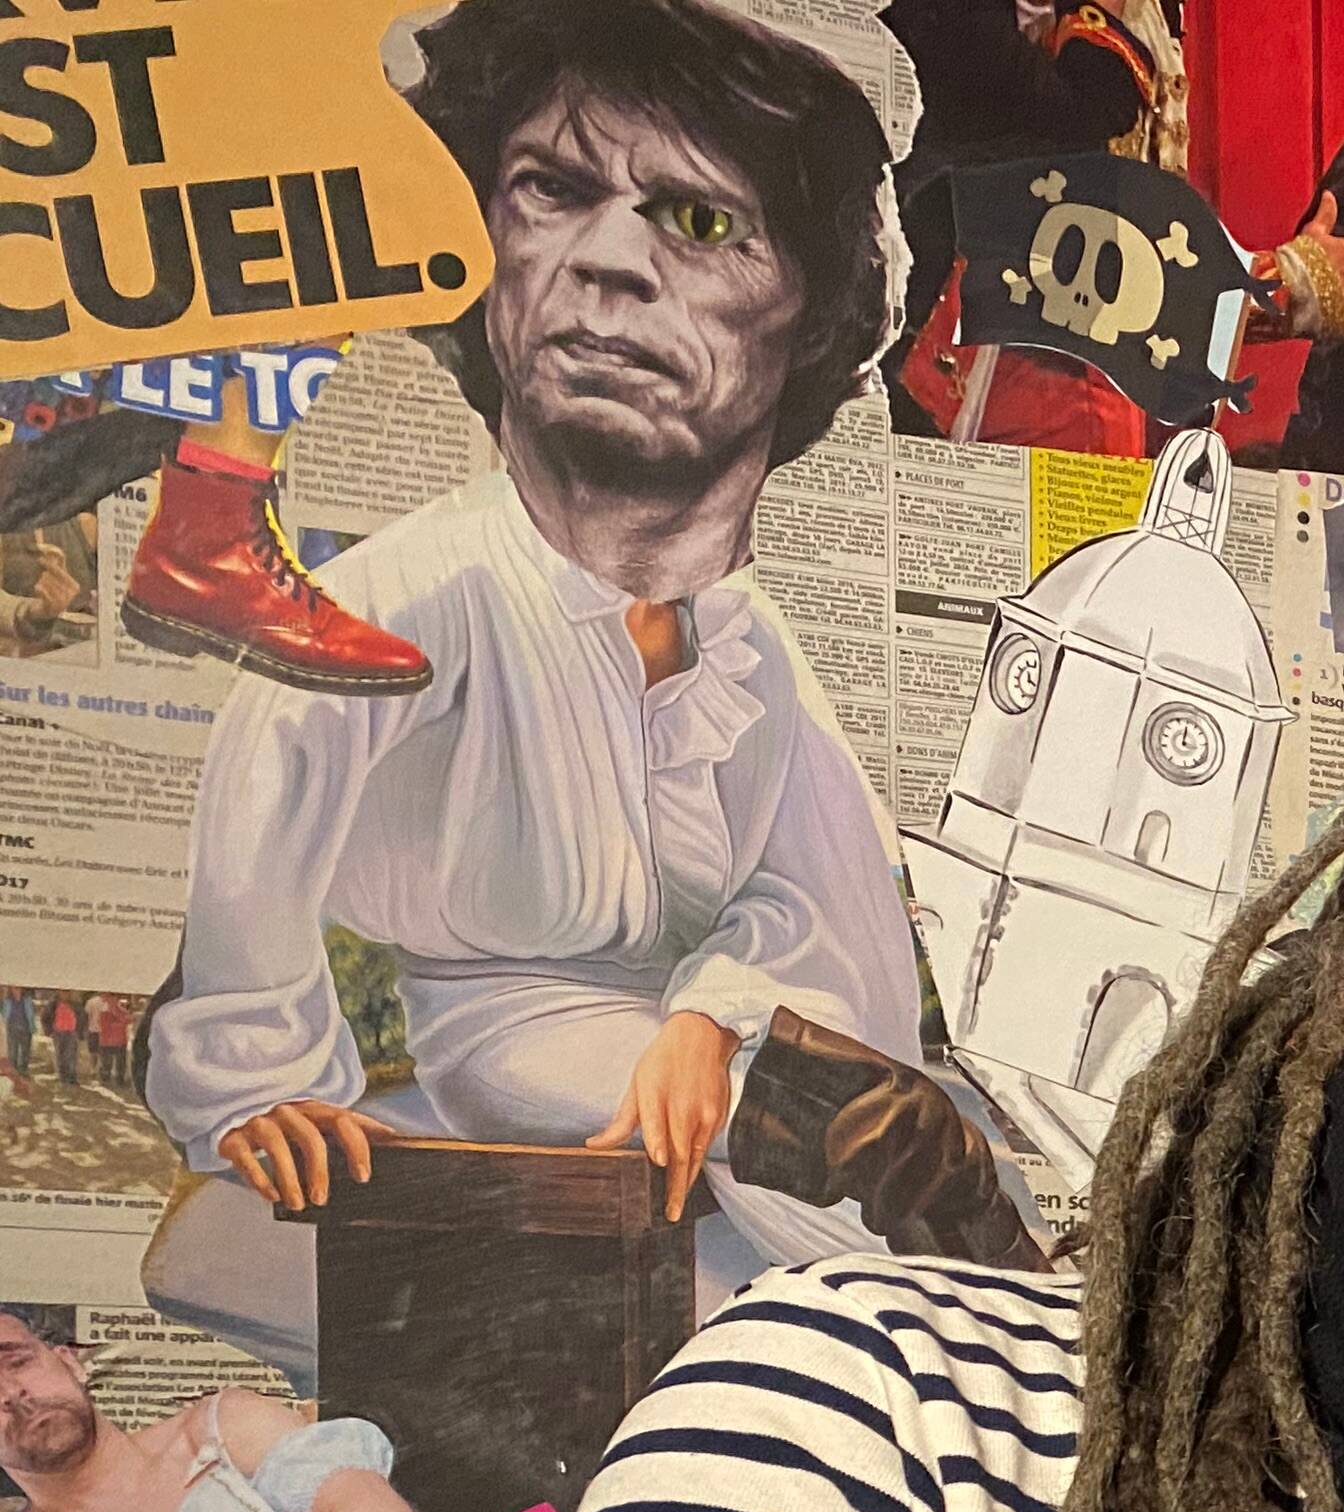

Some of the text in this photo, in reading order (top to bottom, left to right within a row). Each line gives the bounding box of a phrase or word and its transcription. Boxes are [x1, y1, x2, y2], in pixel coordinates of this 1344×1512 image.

[1047, 452, 1071, 465] Tous
[1073, 458, 1100, 470] vieux
[1103, 463, 1146, 478] meubles
[905, 472, 965, 490] PLACES DE PORT
[1047, 475, 1141, 500] Bijoux or ou argent
[1100, 475, 1132, 487] glaces
[1085, 494, 1123, 507] violons
[1047, 499, 1135, 521] Vieilles pendules
[1047, 510, 1076, 522] Vieux
[1047, 522, 1078, 535] Draps
[937, 600, 984, 617] ANIMAUX
[906, 626, 934, 639] CHIENS
[38, 685, 70, 708] les
[77, 693, 148, 717] autres
[906, 745, 929, 757] DONS
[0, 833, 35, 850] TMC
[89, 1311, 156, 1329] Raphaël
[135, 1329, 166, 1342] une
